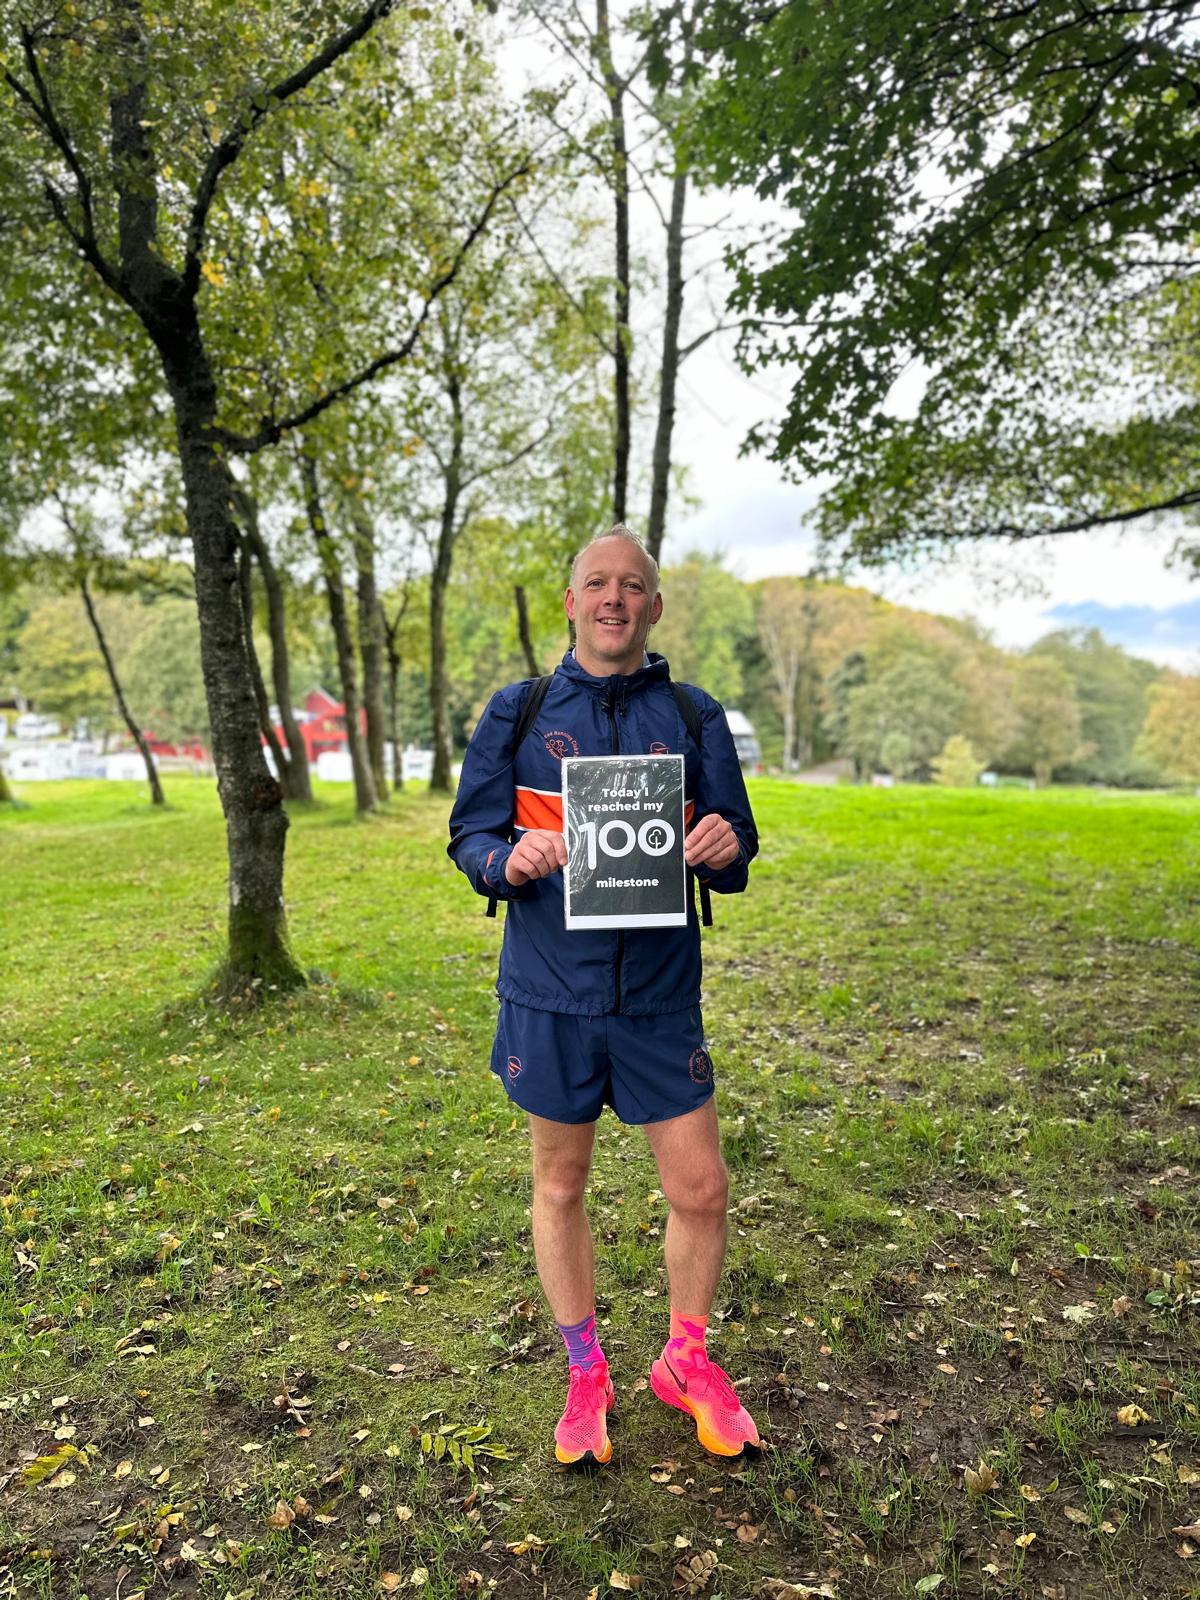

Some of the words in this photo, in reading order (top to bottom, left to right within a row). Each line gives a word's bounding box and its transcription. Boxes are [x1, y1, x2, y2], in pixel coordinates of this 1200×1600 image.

[602, 788, 642, 798] Today
[645, 787, 649, 797] I
[588, 801, 640, 812] reached
[643, 802, 664, 812] my
[578, 818, 675, 870] 100
[596, 877, 659, 888] milestone
